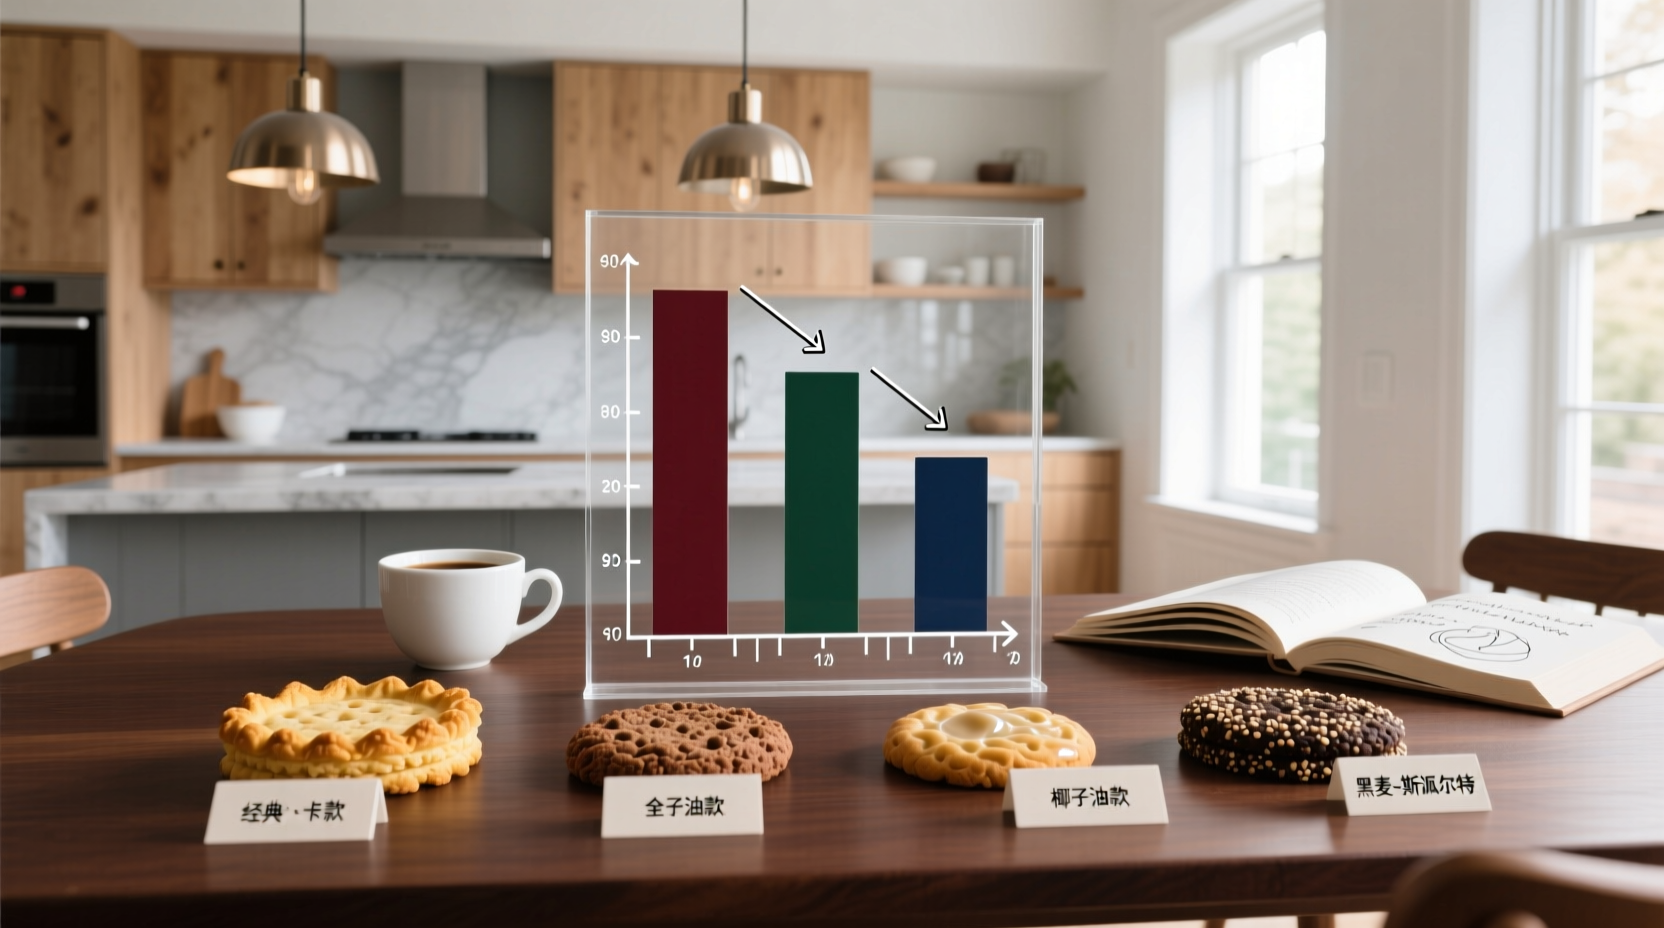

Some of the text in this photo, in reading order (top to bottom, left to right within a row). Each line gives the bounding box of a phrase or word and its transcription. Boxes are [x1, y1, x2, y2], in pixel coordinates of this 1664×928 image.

[602, 480, 620, 493] 20
[602, 553, 620, 567] 90
[683, 654, 702, 668] 10
[1050, 785, 1130, 809] 椰子油款
[645, 796, 725, 817] 全子油款
